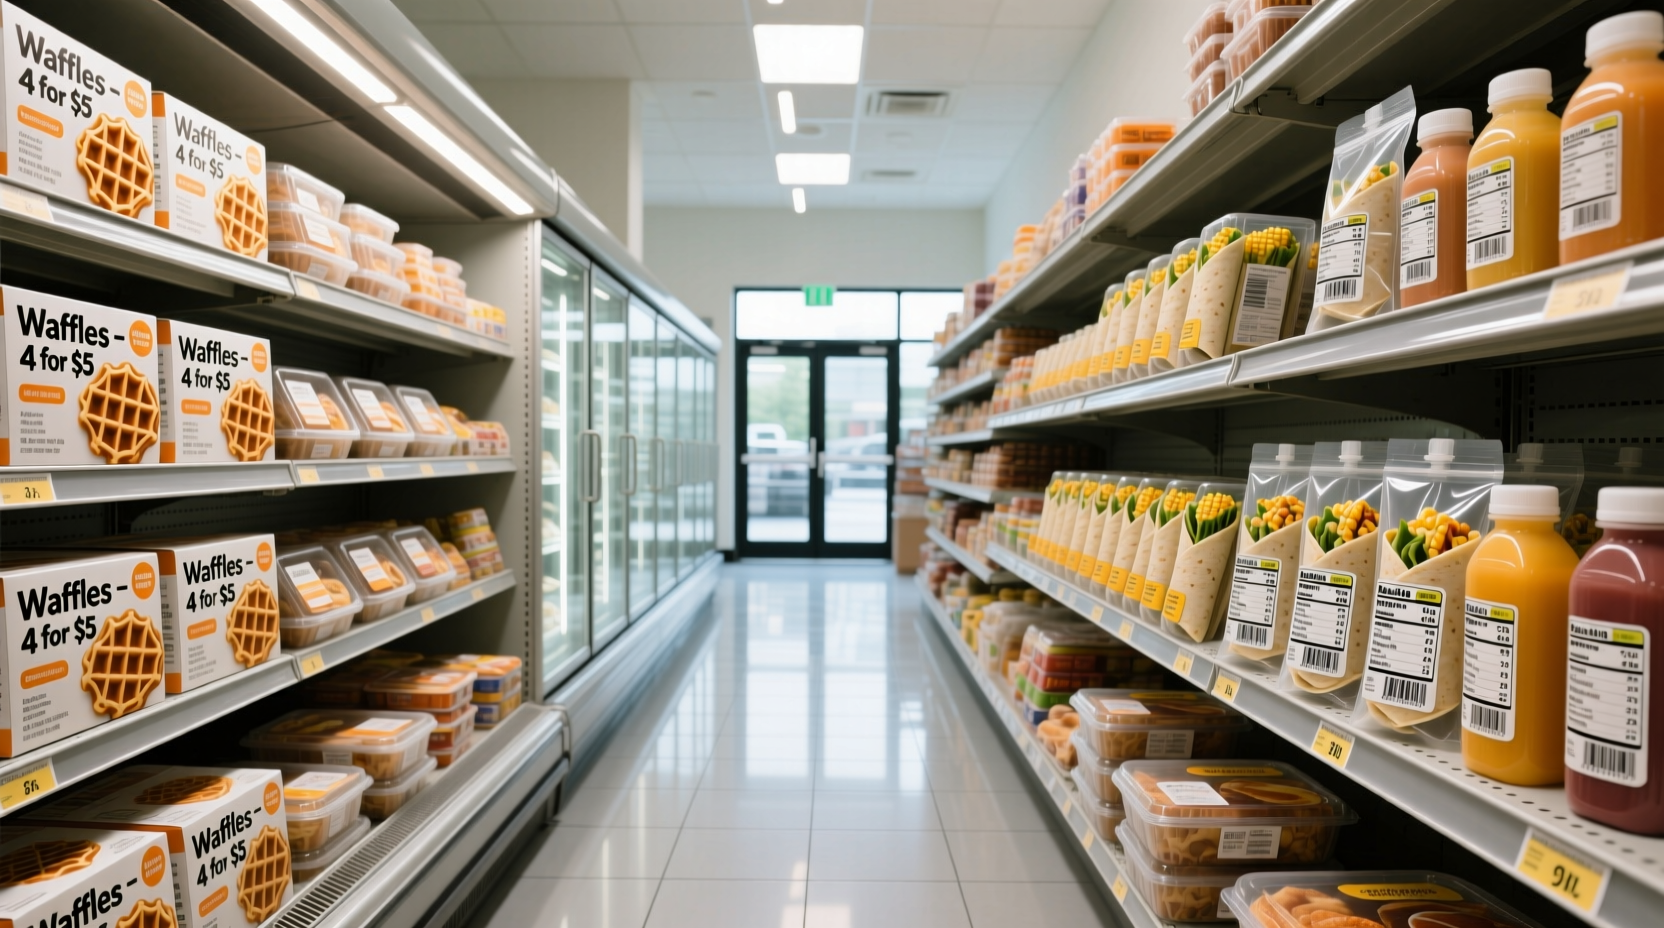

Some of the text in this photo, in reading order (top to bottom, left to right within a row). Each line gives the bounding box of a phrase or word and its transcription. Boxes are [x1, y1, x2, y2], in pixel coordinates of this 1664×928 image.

[16, 23, 105, 96] Waffles
[18, 68, 35, 95] 4
[39, 75, 66, 106] for
[70, 88, 92, 118] $5
[174, 112, 232, 160] Waffles
[176, 144, 224, 179] 4 for $5
[17, 305, 110, 348] Waffles
[20, 345, 94, 378] 4 for $5
[178, 335, 238, 367] Waffles
[181, 368, 230, 393] 4 for $5
[183, 554, 243, 586] Waffles
[17, 578, 112, 621] Waffles
[186, 583, 236, 612] 4 for $5
[21, 616, 96, 654] 4 for $5
[192, 811, 252, 859] Waffles
[197, 839, 246, 887] 4 for $5
